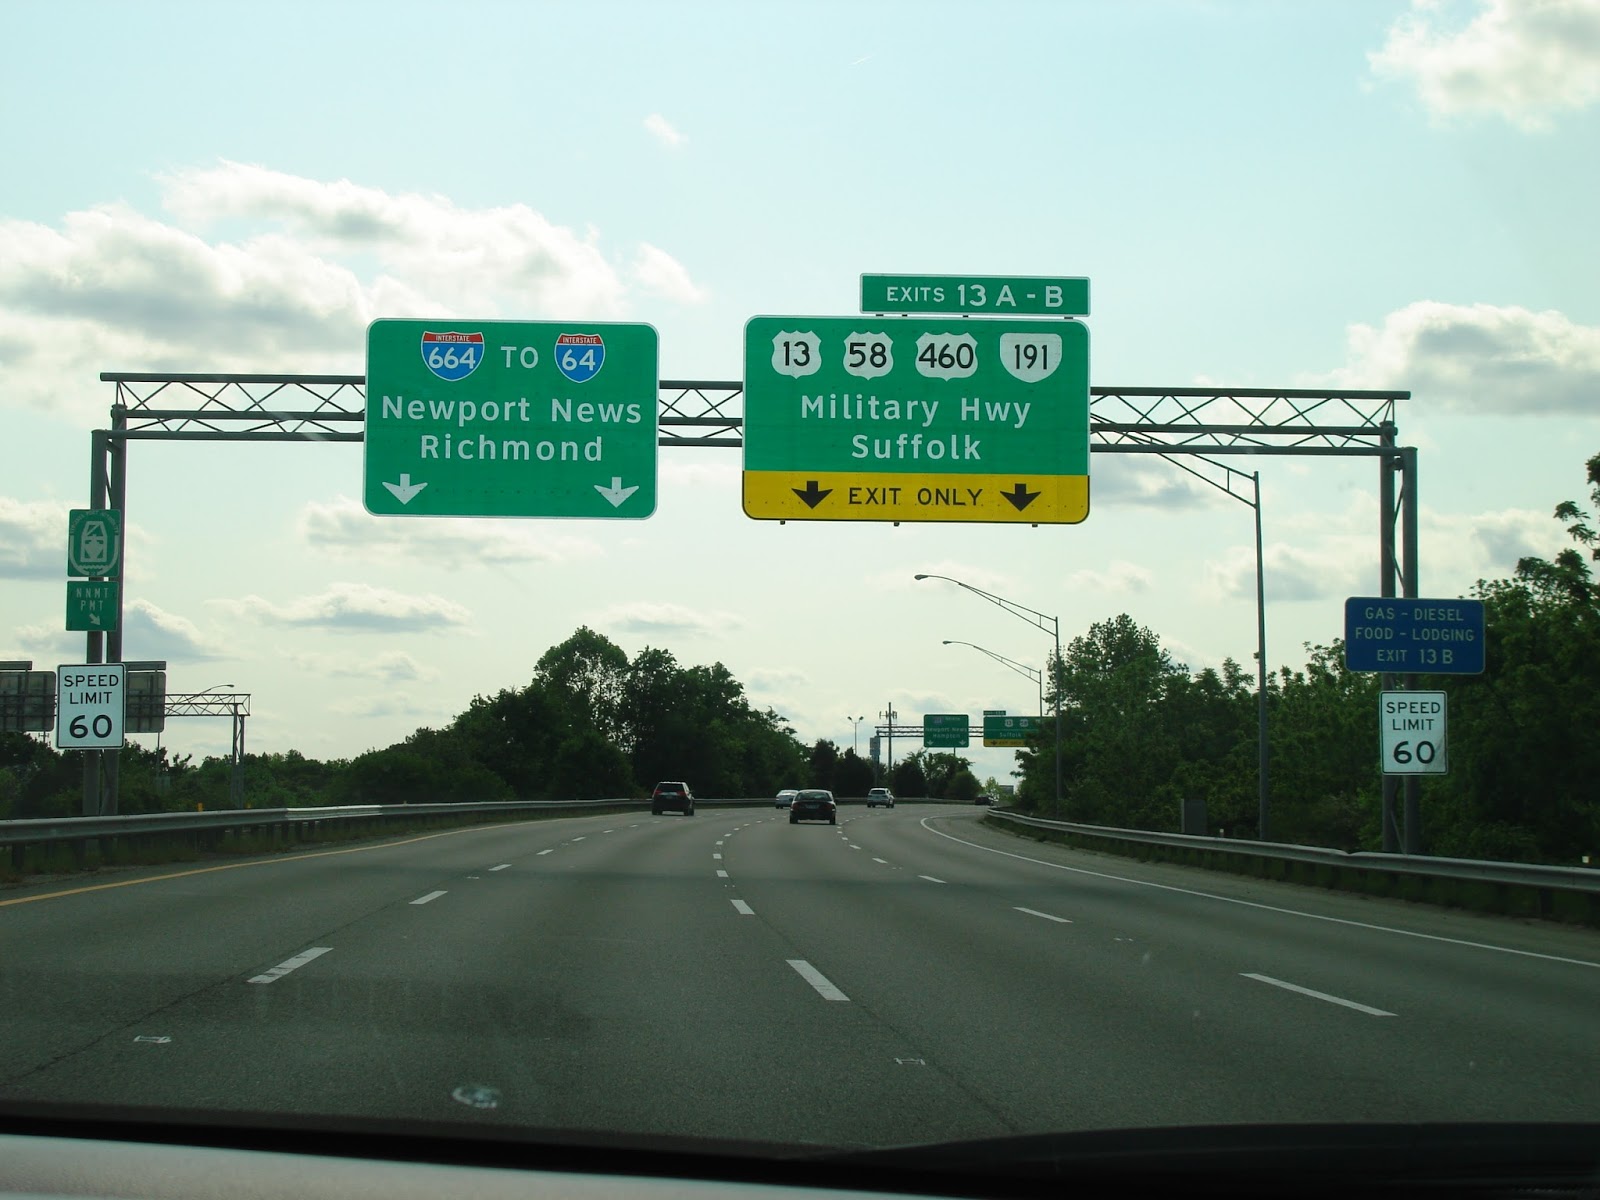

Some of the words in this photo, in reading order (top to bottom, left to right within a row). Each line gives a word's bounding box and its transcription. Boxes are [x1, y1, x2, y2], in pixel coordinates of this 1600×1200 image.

[887, 286, 945, 302] EXITS
[957, 284, 987, 306] 13
[995, 285, 1016, 307] A
[1045, 286, 1063, 308] B
[435, 334, 470, 342] INTERSTATE
[562, 336, 597, 344] INTERSTATE
[428, 347, 476, 369] 664
[501, 346, 539, 368] TO
[562, 349, 596, 371] 64
[783, 341, 811, 366] 13
[849, 342, 887, 368] 58
[918, 343, 974, 369] 460
[1014, 344, 1048, 370] 191
[382, 395, 530, 427] Newport
[552, 398, 642, 423] News
[801, 394, 939, 427] Military
[961, 397, 1031, 428] Hwy
[421, 433, 602, 461] Richmond
[851, 434, 981, 460] Suffolk
[849, 487, 901, 505] EXIT
[917, 488, 983, 506] ONLY
[76, 587, 110, 599] NNMT
[80, 600, 104, 611] PMT
[1365, 607, 1395, 620] GAS
[1414, 608, 1464, 621] DIESEL
[1355, 627, 1393, 640] FOOD
[1412, 628, 1475, 642] LODGING
[1377, 649, 1408, 662] EXIT
[1420, 649, 1437, 664] 13
[1443, 650, 1453, 664] B
[64, 674, 119, 688] SPEED
[69, 692, 113, 705] LIMIT
[1386, 701, 1441, 714] SPEED
[69, 714, 113, 739] 60
[1392, 718, 1435, 731] LIMIT
[1393, 740, 1435, 764] 60
